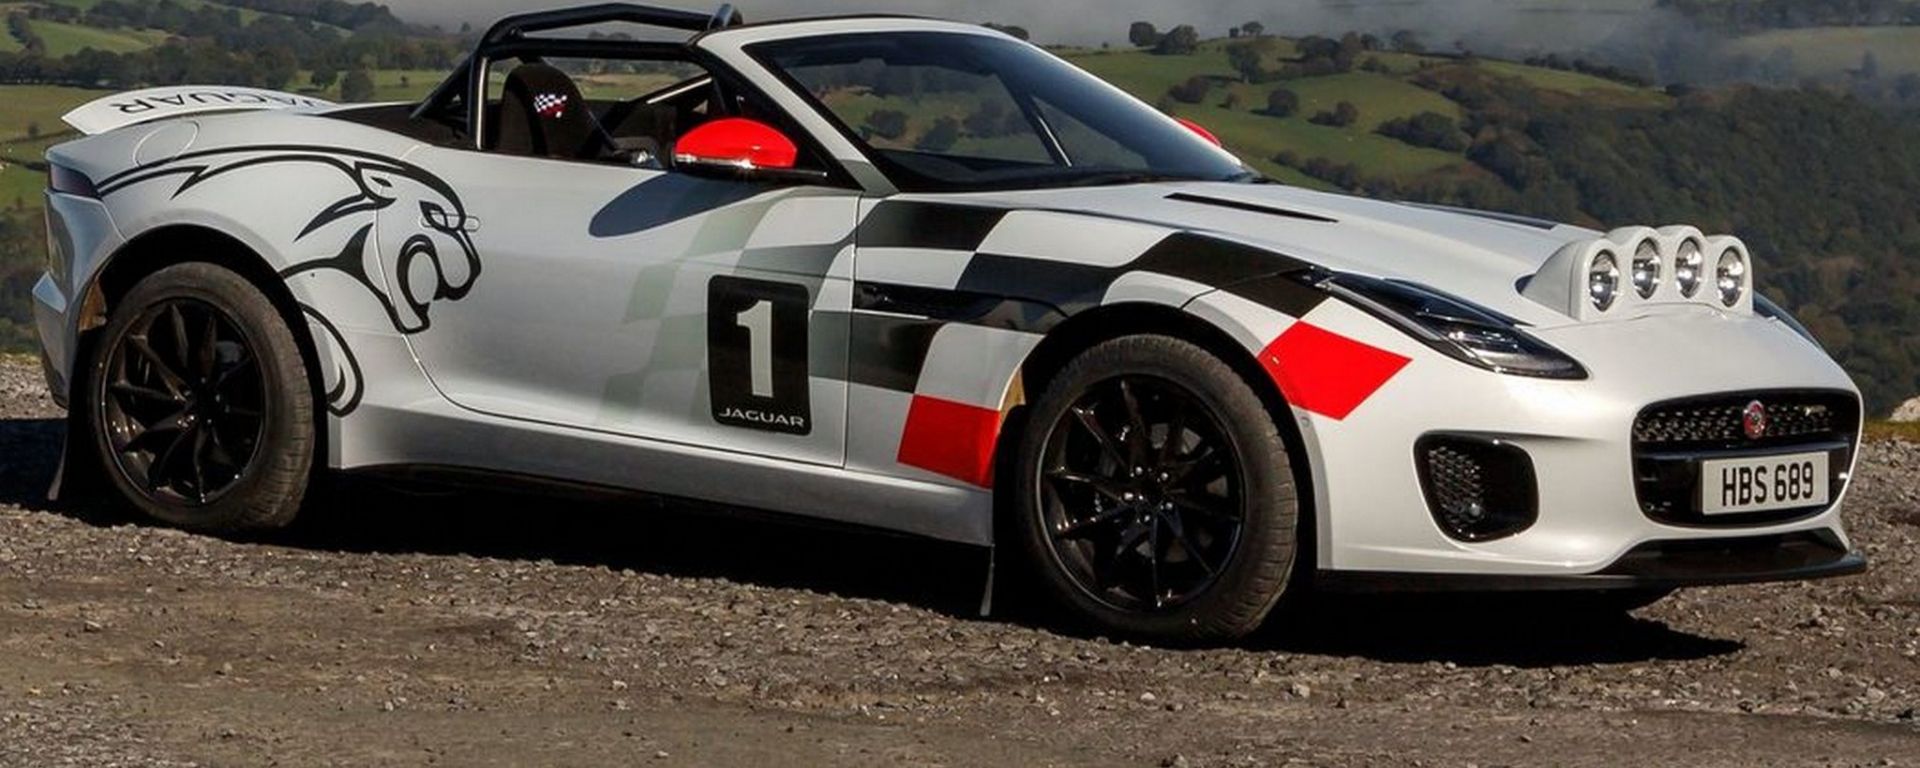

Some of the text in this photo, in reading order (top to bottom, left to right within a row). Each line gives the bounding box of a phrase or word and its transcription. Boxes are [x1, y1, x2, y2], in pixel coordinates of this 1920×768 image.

[737, 300, 772, 398] 1
[719, 407, 804, 427] JAGUAR
[1722, 461, 1813, 506] HBS 689
